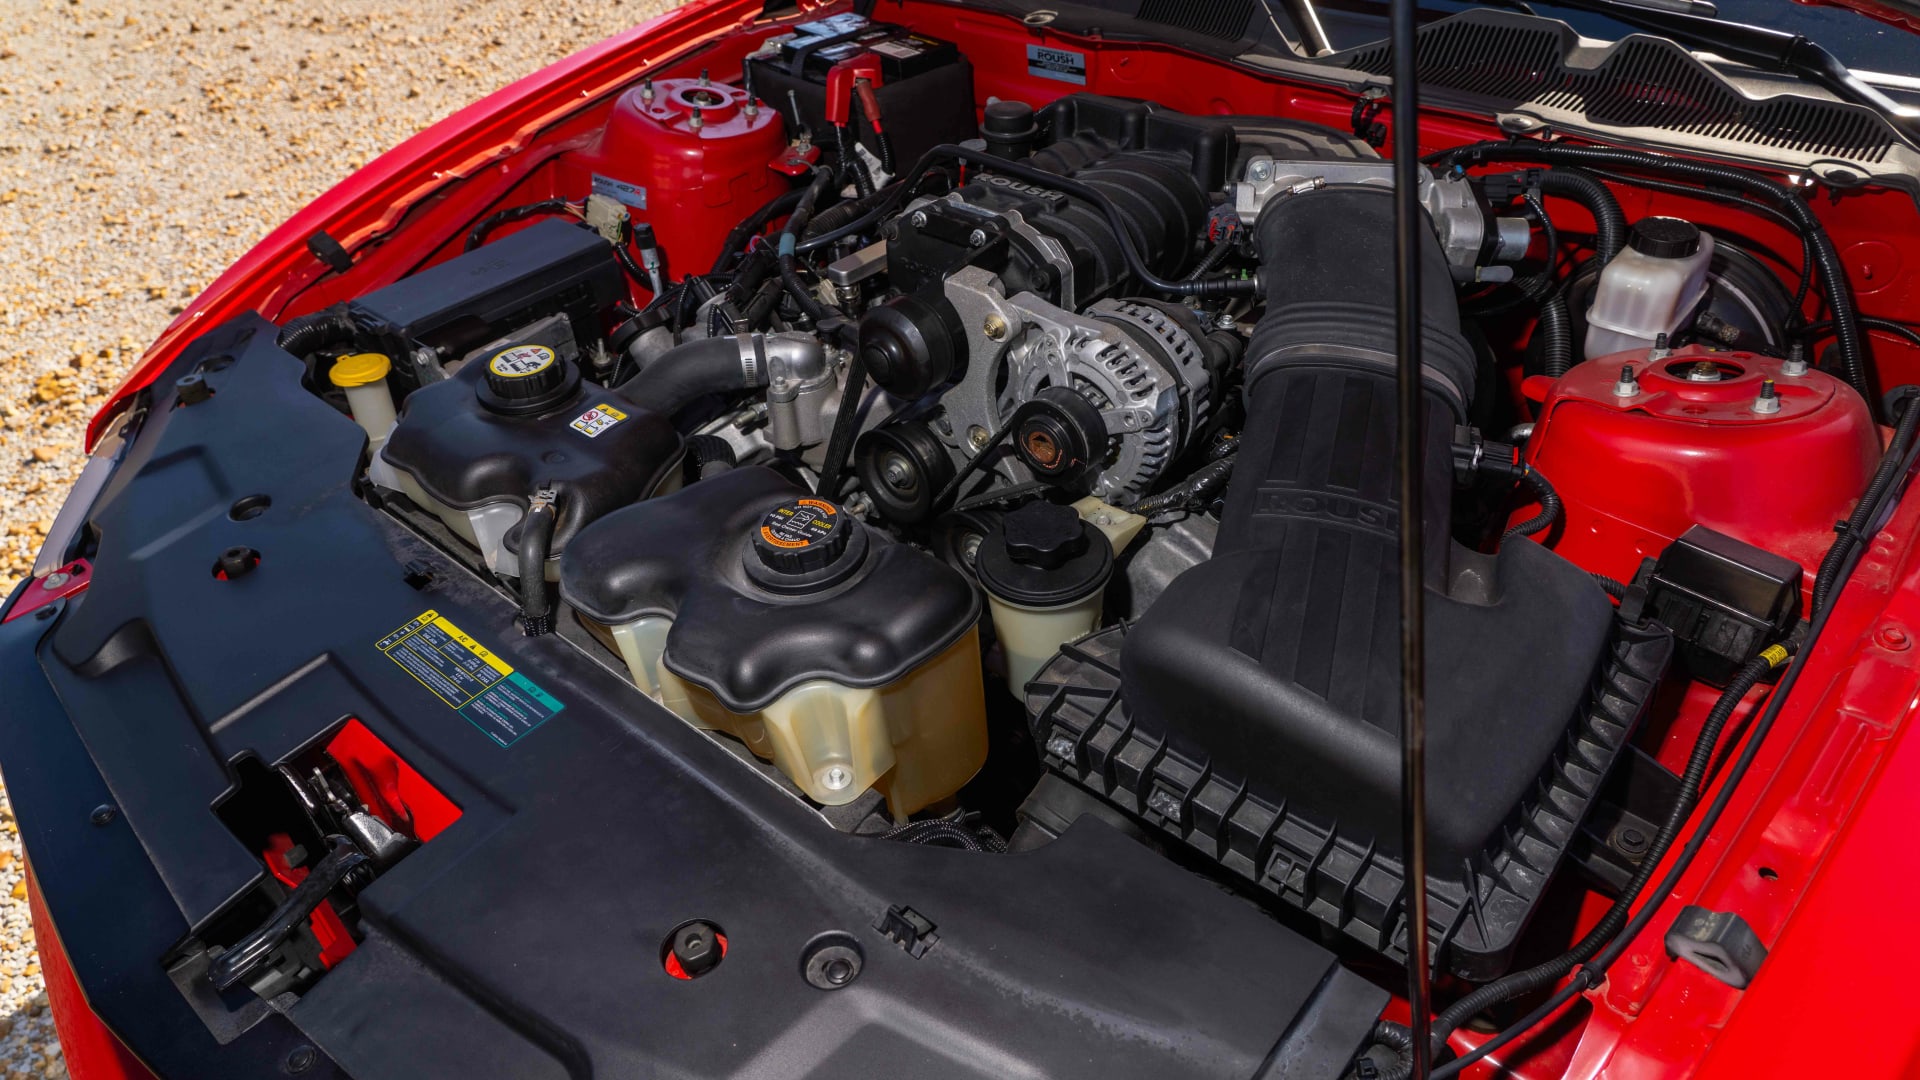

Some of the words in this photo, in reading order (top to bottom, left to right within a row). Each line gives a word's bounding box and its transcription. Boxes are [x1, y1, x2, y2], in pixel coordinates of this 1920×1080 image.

[1038, 51, 1074, 65] ROUSH
[973, 173, 1065, 201] ROUSH
[777, 508, 794, 516] INTER
[812, 519, 832, 529] COOLER
